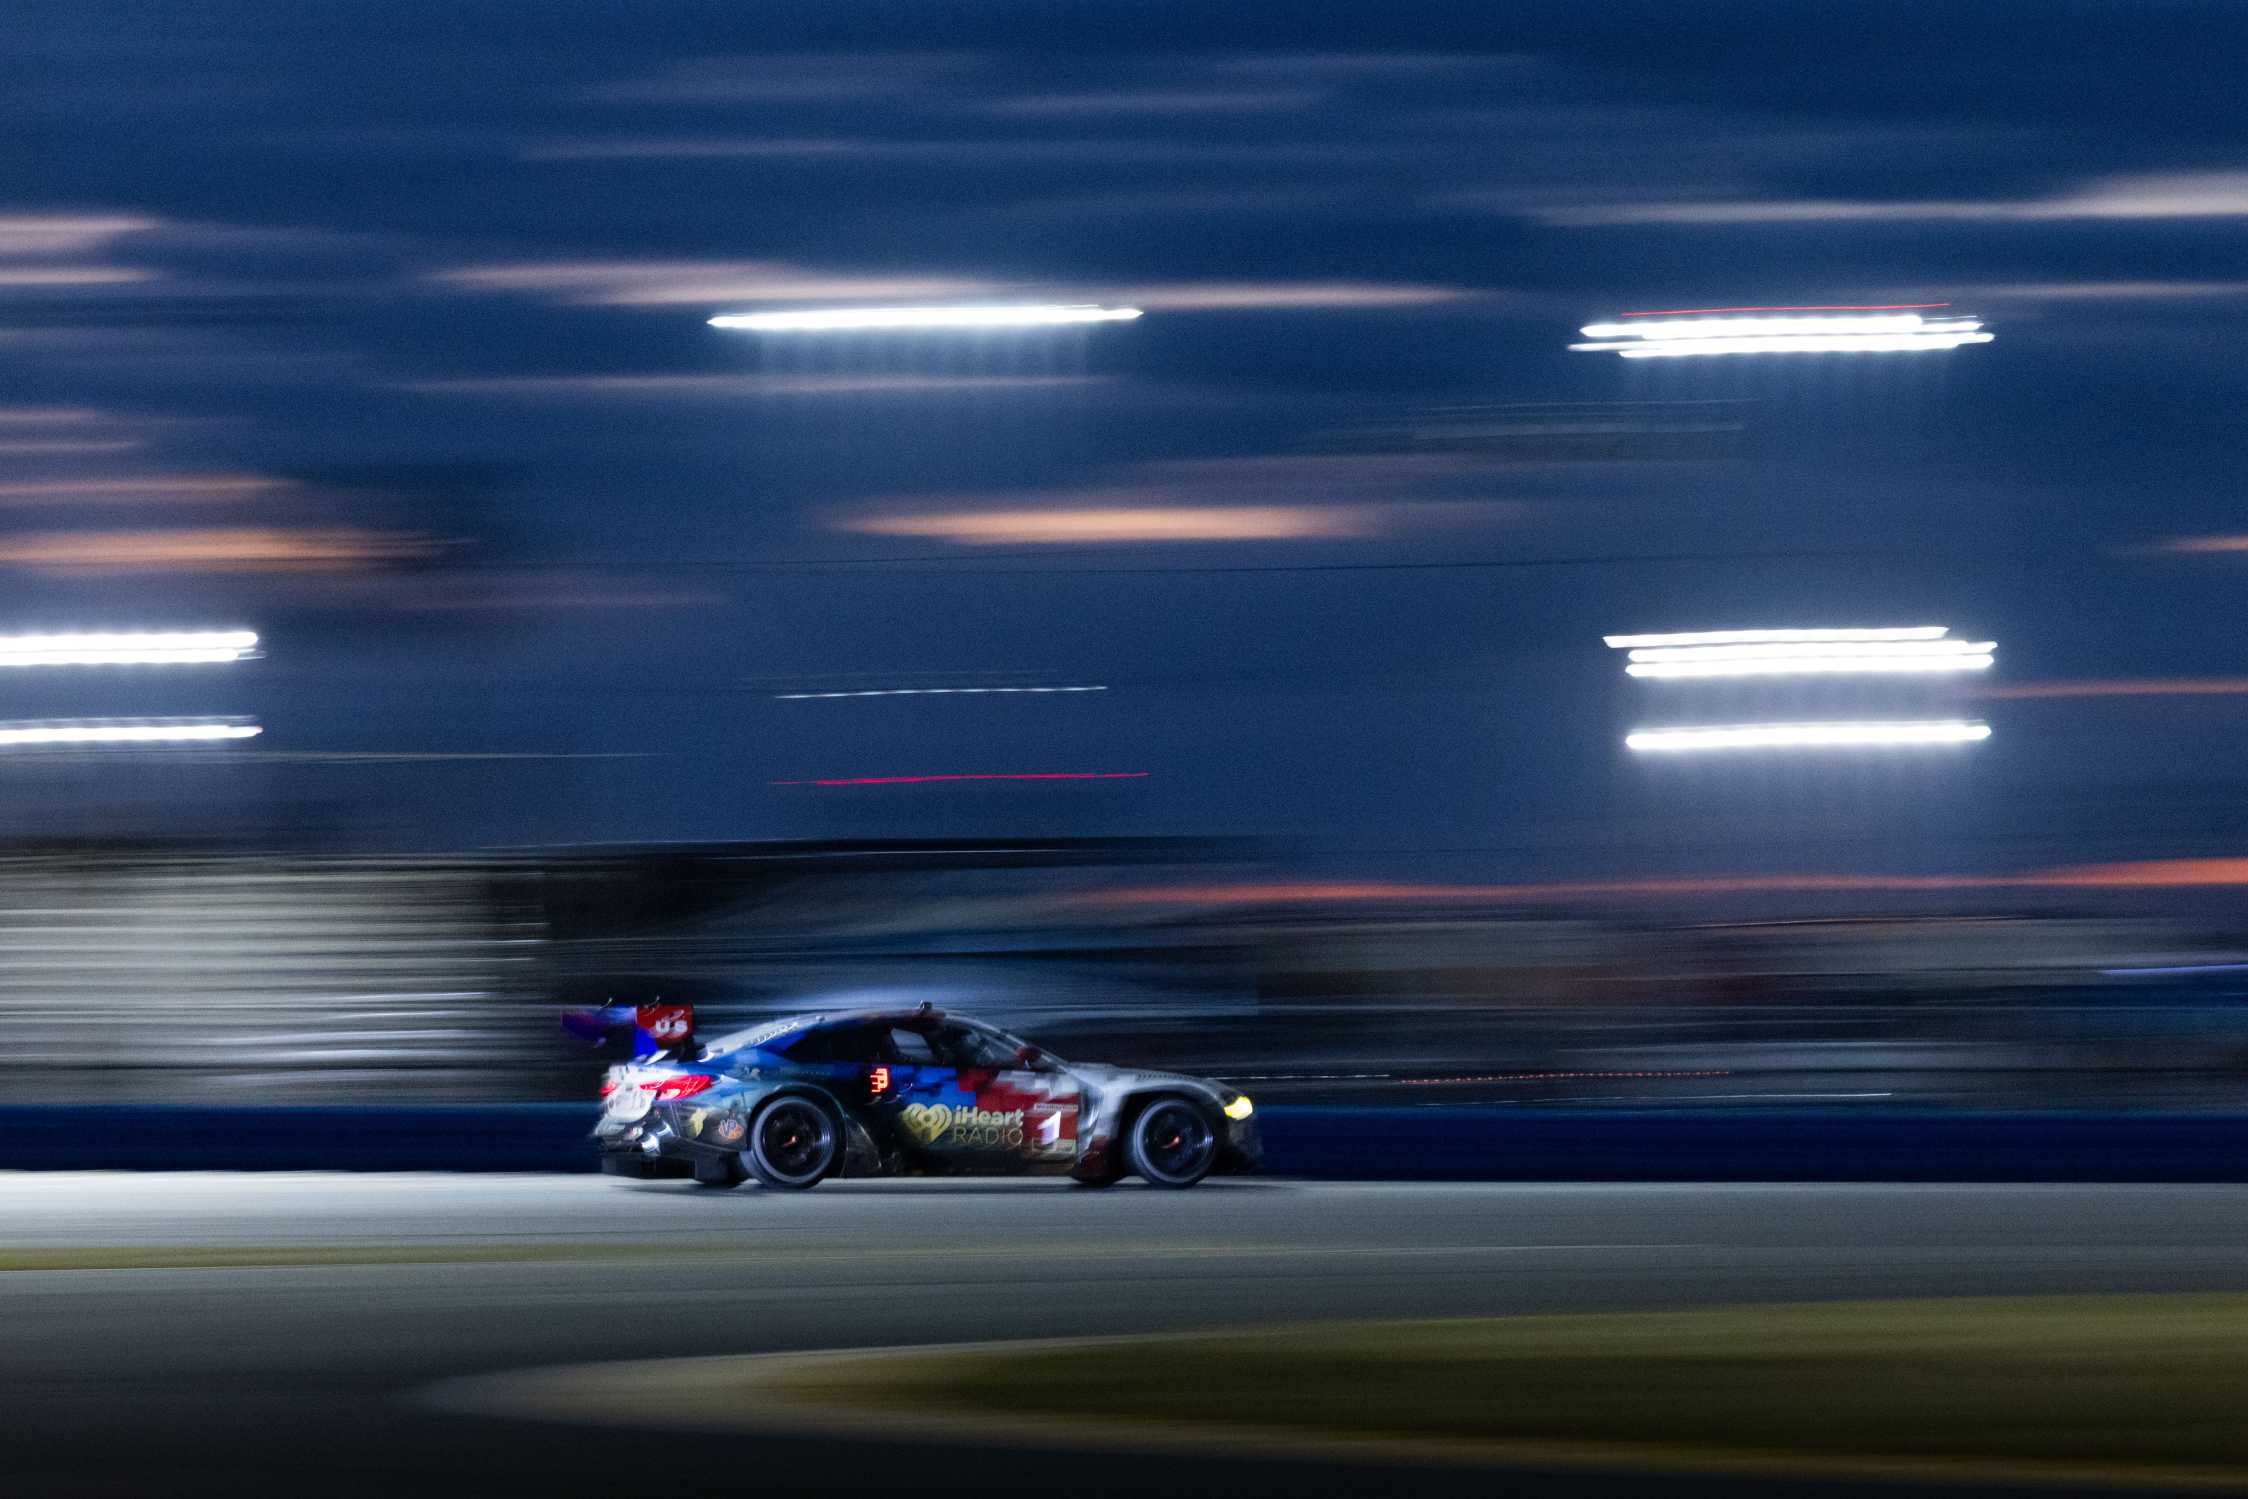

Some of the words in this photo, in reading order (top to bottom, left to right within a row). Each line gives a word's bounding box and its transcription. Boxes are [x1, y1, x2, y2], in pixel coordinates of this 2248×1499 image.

[955, 1105, 1024, 1127] iHeart
[953, 1127, 1023, 1147] RADIO
[1037, 1110, 1062, 1145] 1
